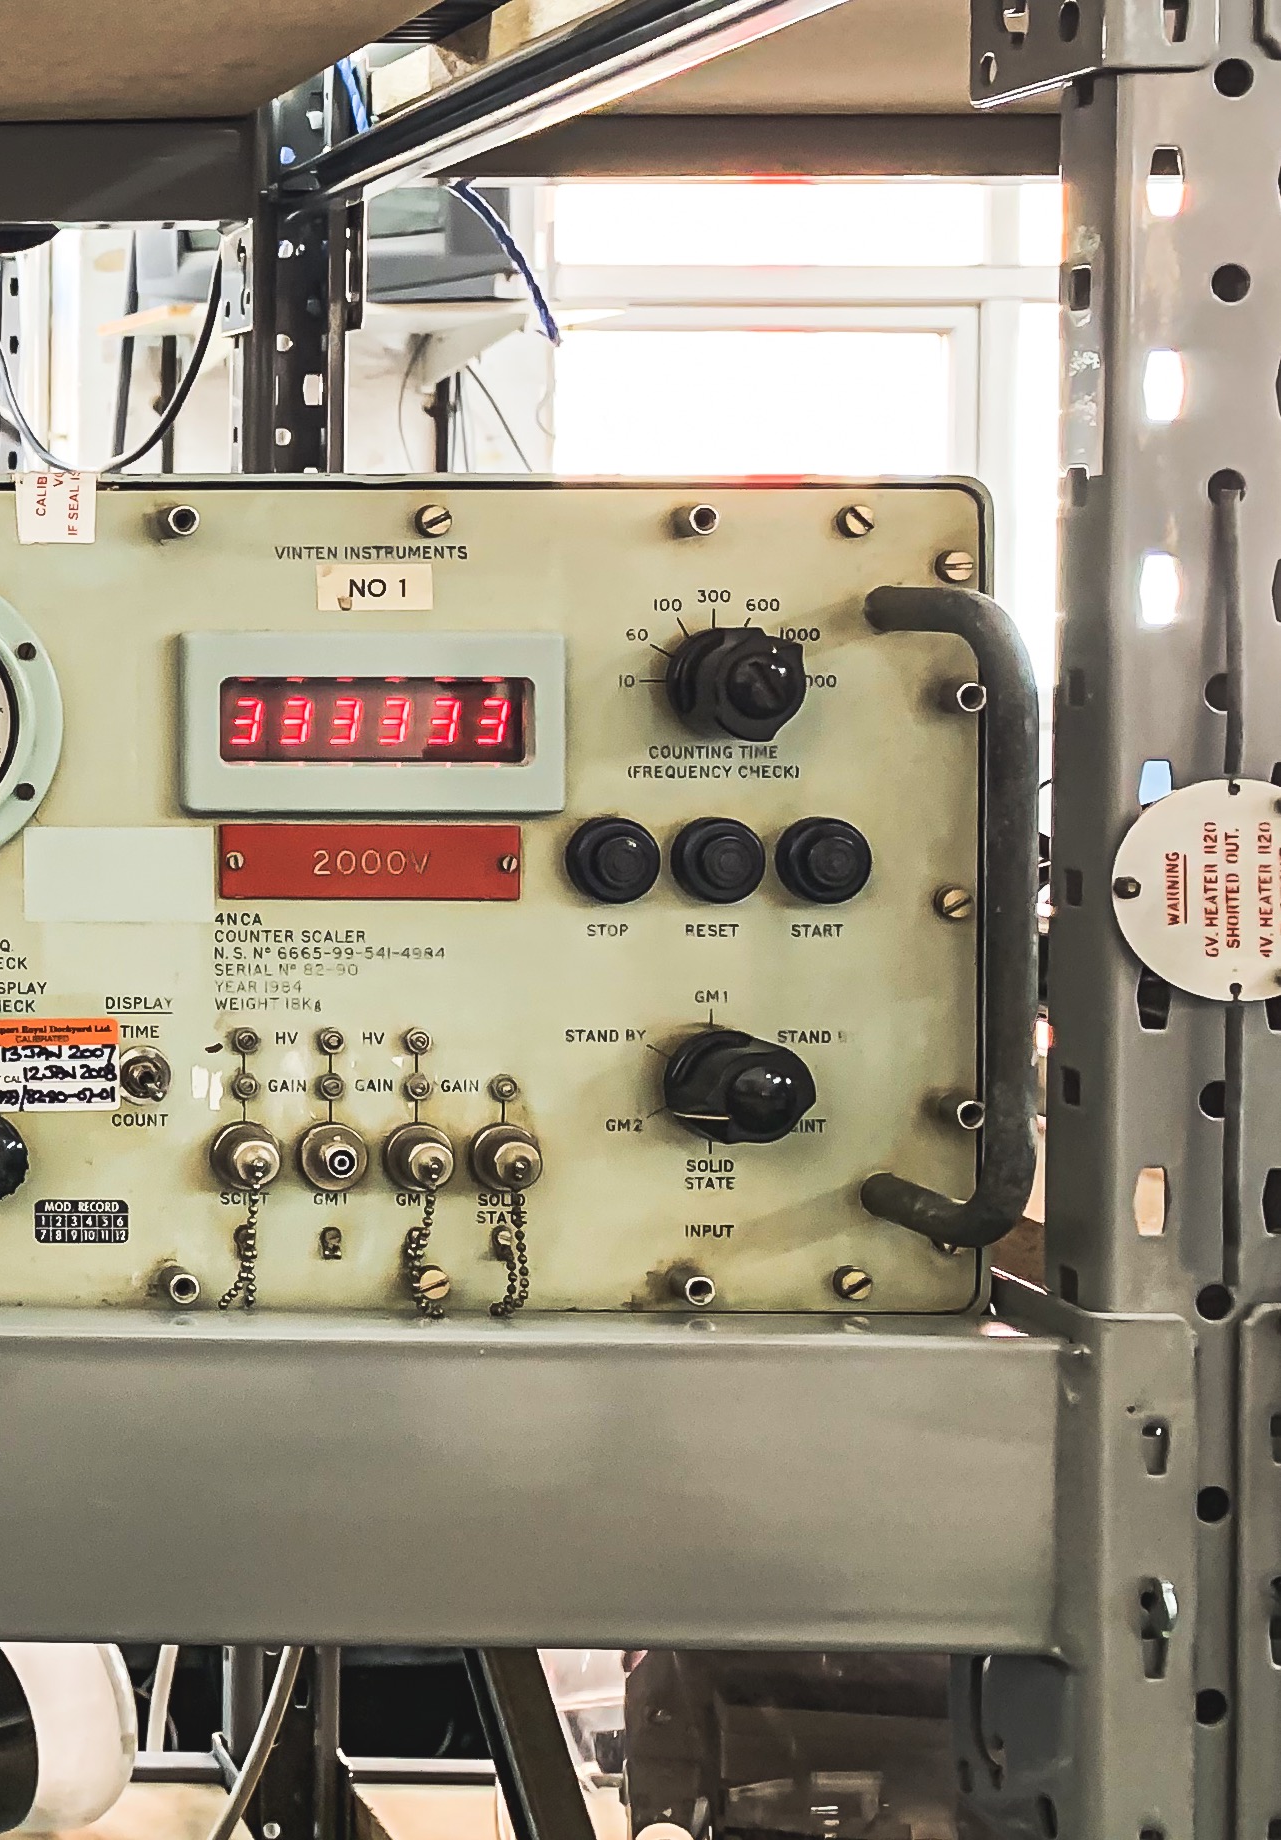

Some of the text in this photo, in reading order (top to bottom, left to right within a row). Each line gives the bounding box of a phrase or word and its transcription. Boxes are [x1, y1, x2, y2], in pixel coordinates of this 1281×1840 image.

[68, 485, 79, 535] IF SEAL
[274, 546, 468, 560] VINTEN INSTRUMENTS
[349, 579, 406, 597] NO 1
[697, 590, 731, 602] 300
[653, 599, 682, 611] 100
[746, 598, 780, 611] 600
[626, 629, 648, 641] 60
[779, 628, 821, 641] 1000
[618, 675, 635, 687] 10
[230, 698, 511, 745] 333333
[649, 746, 778, 760] COUNTING TIME
[627, 766, 799, 778] (FREQUENCY CHECK)
[313, 850, 430, 875] 2000V
[1166, 852, 1180, 926] WARNING
[1204, 864, 1219, 927] HEATER
[1259, 864, 1273, 927] HEATER
[1225, 874, 1241, 949] SHORTED
[215, 930, 366, 943] COUNTER SCALER
[587, 924, 629, 937] STOP
[686, 924, 739, 937] RESET
[791, 924, 844, 937] START
[278, 947, 445, 959] 6665-99-541-4984
[215, 964, 359, 976] SERIAL 82-90
[215, 980, 302, 993] YEAR 1984
[105, 997, 173, 1009] DISPLAY
[215, 998, 279, 1010] WEIGHT
[121, 1025, 159, 1038] TIME
[275, 1032, 385, 1044] HV HV
[565, 1030, 646, 1042] STAND BY
[778, 1031, 832, 1044] STAND
[16, 1035, 69, 1043] CALIBRATED
[68, 1044, 116, 1063] 2007
[80, 1064, 117, 1081] 2008
[268, 1079, 479, 1092] GAIN GAIN GAIN
[112, 1114, 168, 1126] COUNT
[606, 1119, 643, 1132] GM2
[686, 1159, 734, 1173] SOLID
[685, 1177, 736, 1190] STATE
[78, 1202, 119, 1212] RECORD
[685, 1225, 735, 1238] INPUT
